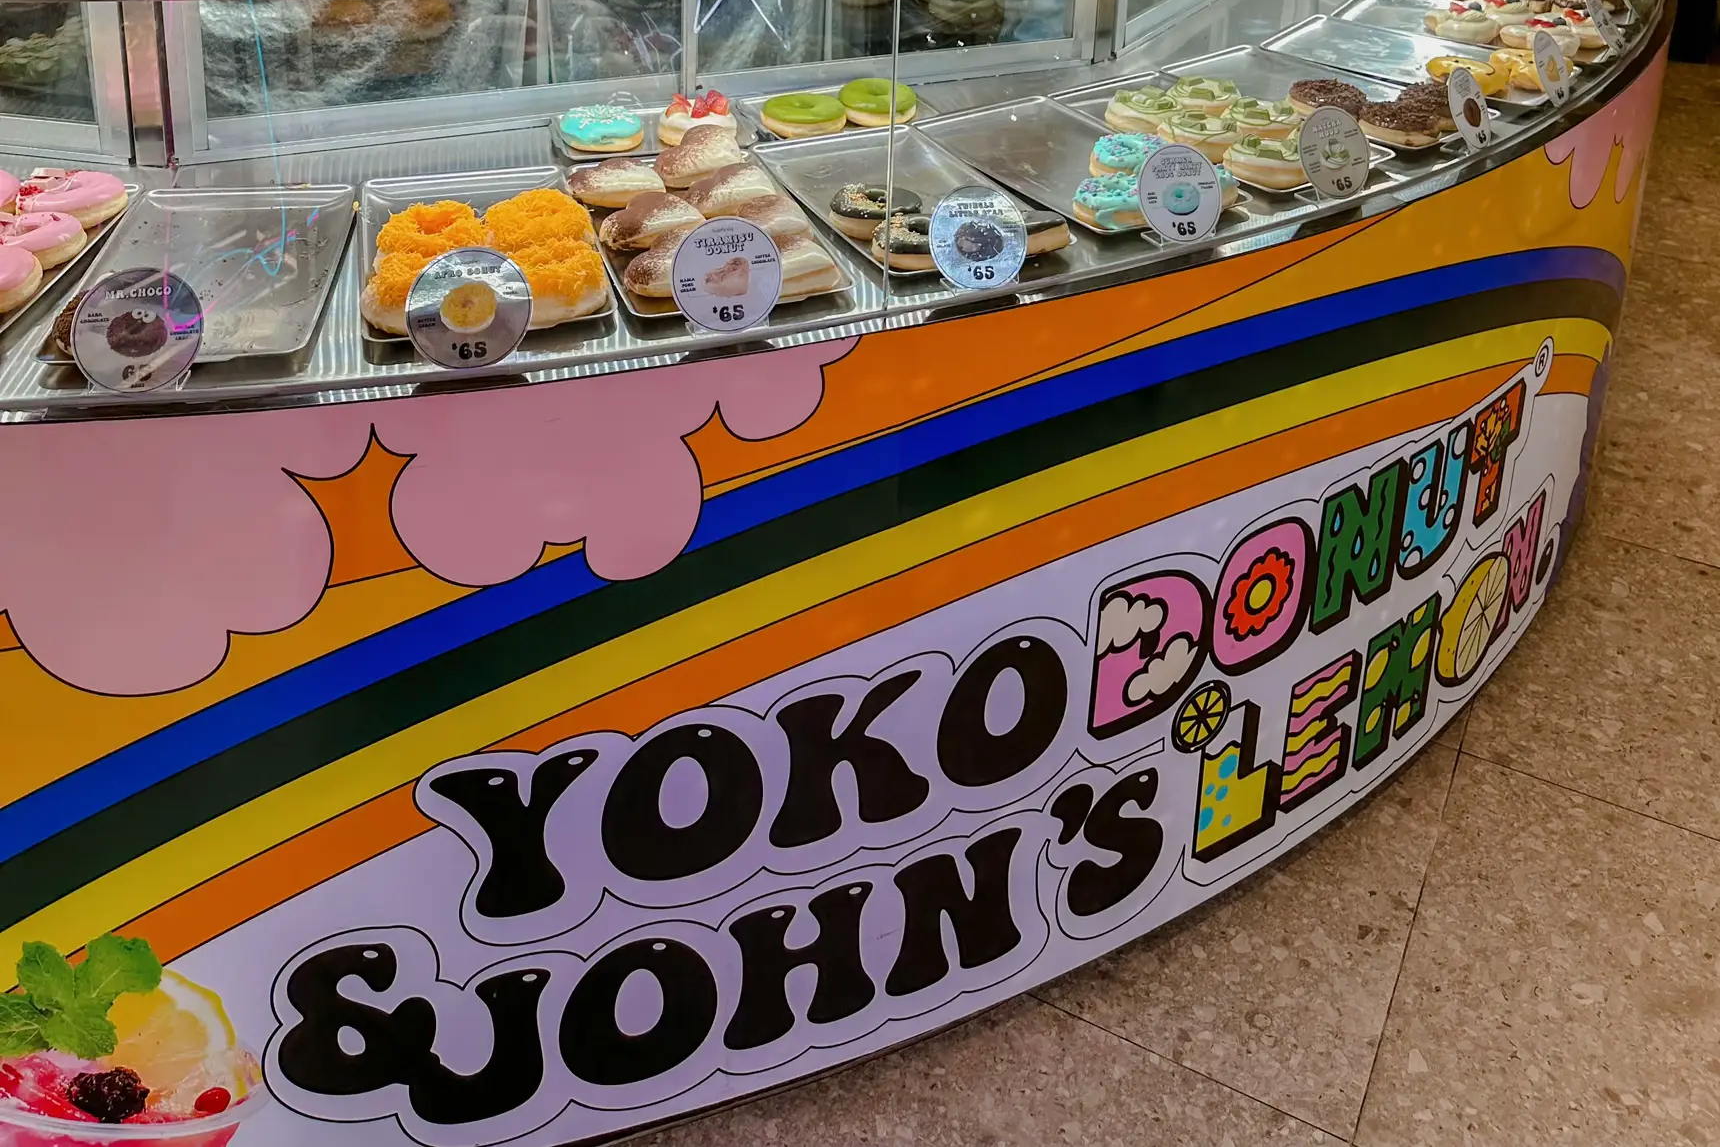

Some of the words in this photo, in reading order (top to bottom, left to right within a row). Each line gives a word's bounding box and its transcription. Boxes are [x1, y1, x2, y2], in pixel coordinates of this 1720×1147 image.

[1312, 118, 1343, 133] MATCHA
[693, 232, 755, 249] TIRAMISU
[705, 242, 745, 256] DONUT
[434, 269, 463, 280] AFRO
[466, 265, 502, 276] DONUT
[428, 634, 1069, 918] YOKO
[1087, 378, 1527, 741] DONUT
[277, 767, 1164, 1125] &JOHN'S
